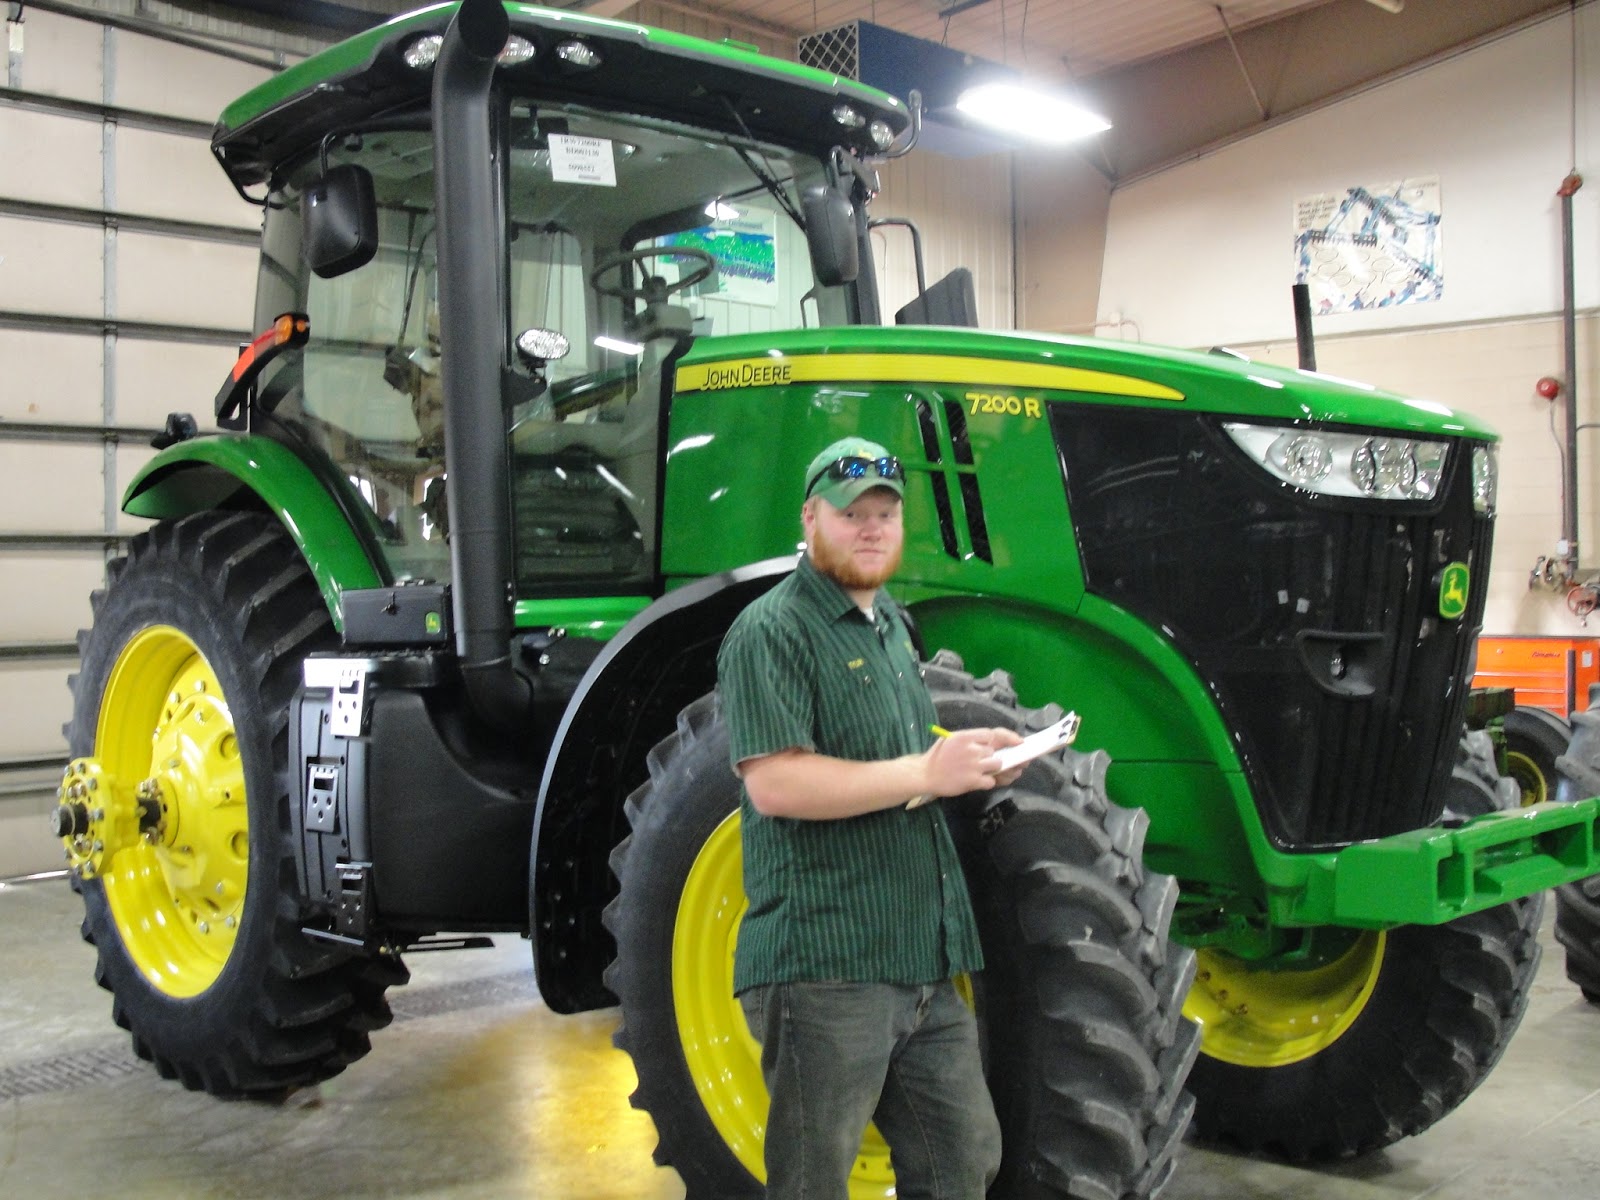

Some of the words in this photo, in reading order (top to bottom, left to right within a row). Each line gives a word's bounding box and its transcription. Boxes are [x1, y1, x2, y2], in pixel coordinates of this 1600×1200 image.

[703, 367, 740, 387] JOHN
[742, 364, 792, 383] DEERE
[965, 392, 1022, 415] 7200
[1023, 397, 1042, 418] R
